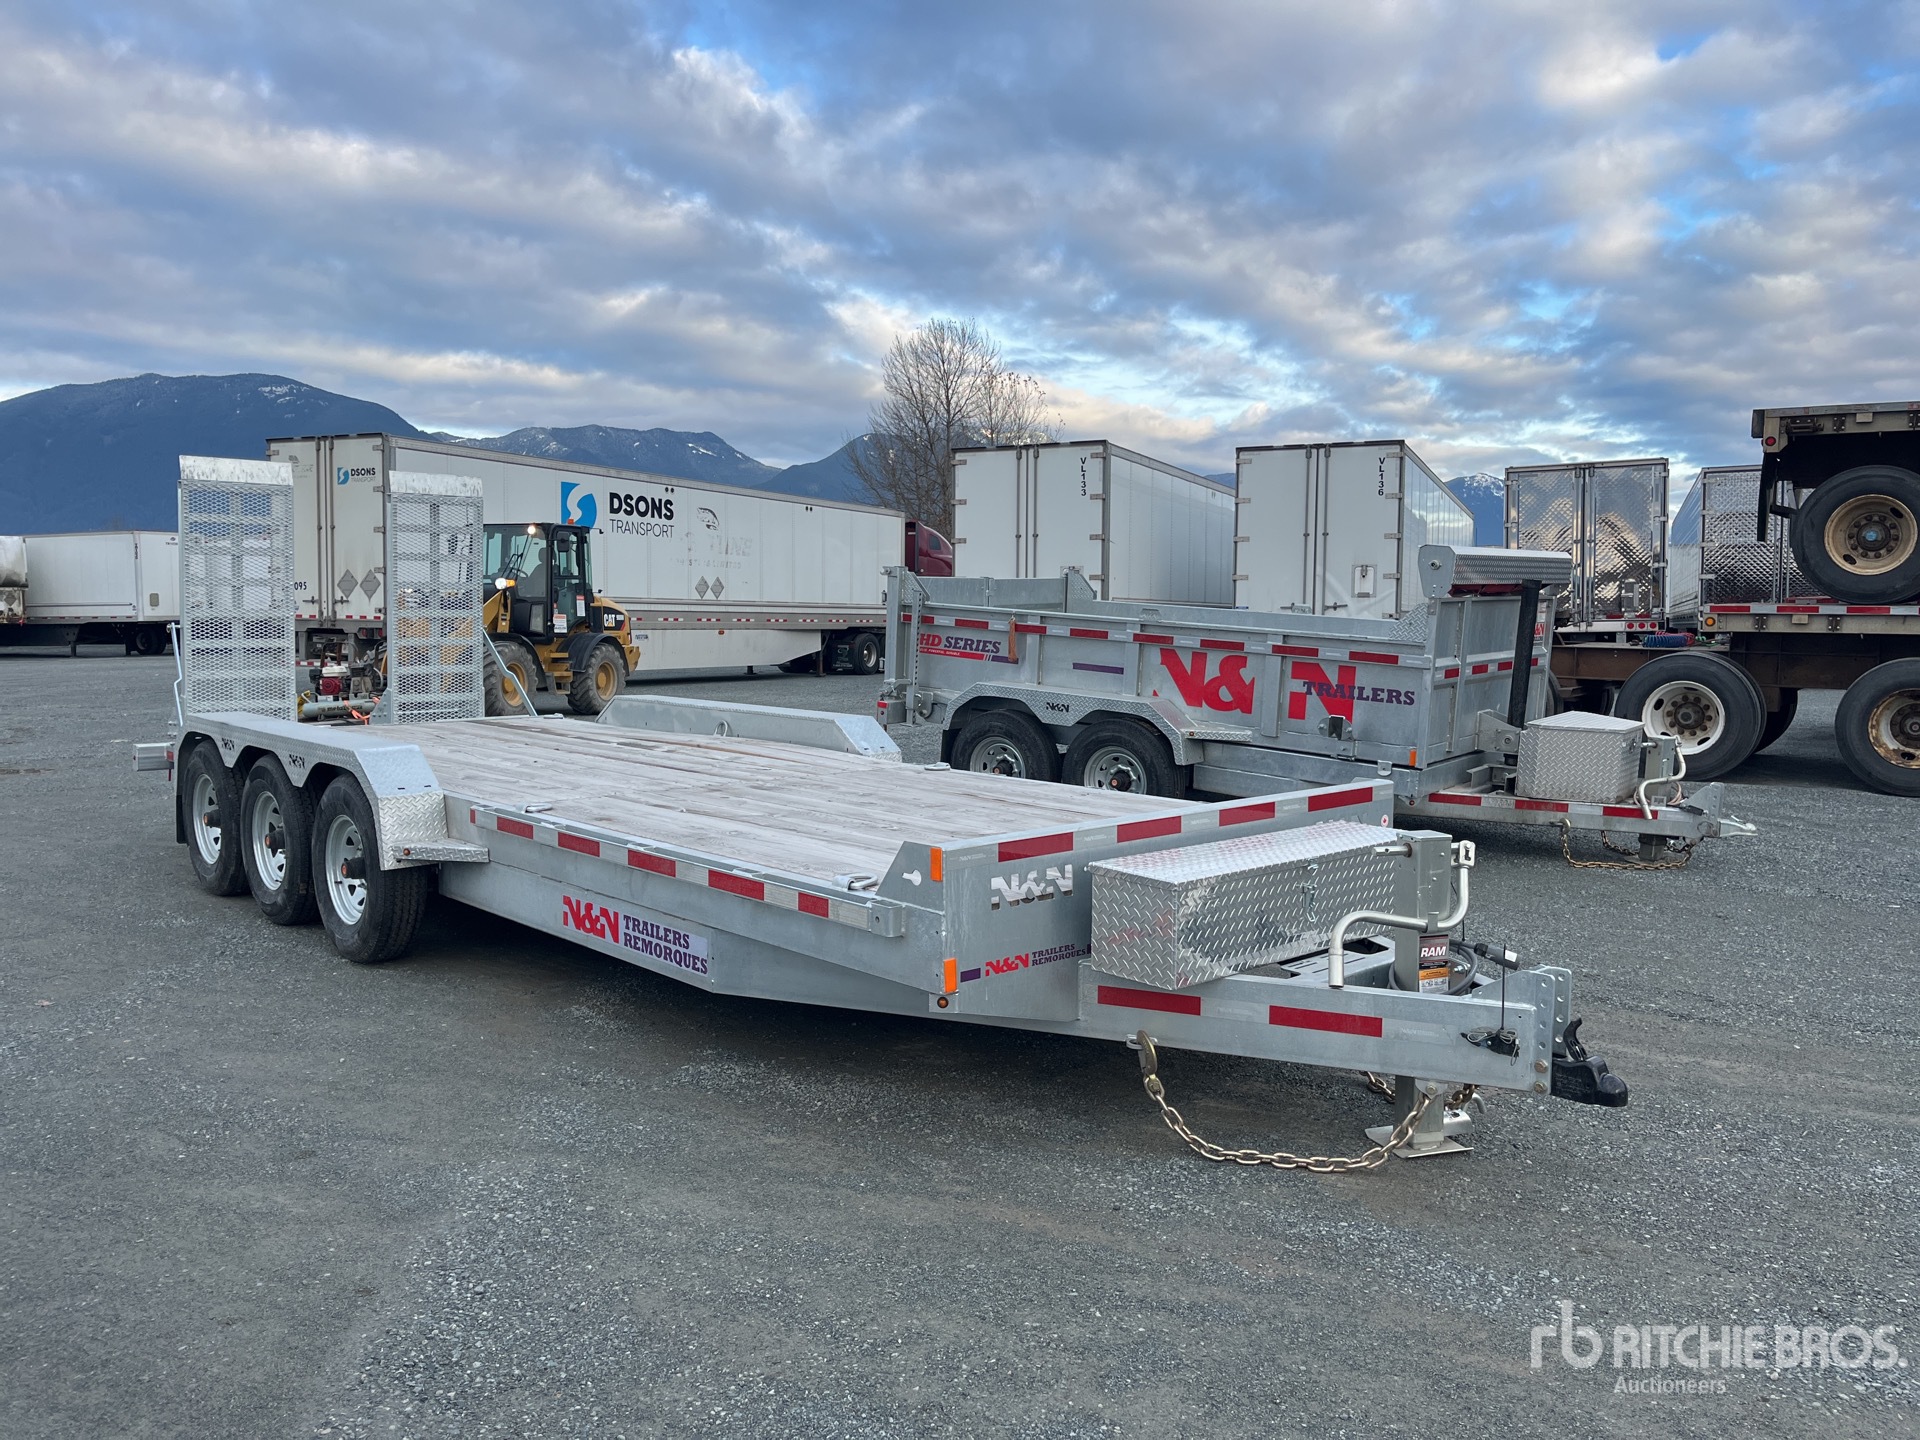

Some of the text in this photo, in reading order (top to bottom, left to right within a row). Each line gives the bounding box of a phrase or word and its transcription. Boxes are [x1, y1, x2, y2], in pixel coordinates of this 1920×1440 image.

[350, 467, 376, 477] DSONS
[1378, 457, 1386, 497] VL136
[609, 492, 675, 521] DSONS
[609, 518, 675, 538] TRANSPORT
[603, 613, 615, 627] CAT
[919, 633, 1002, 654] HD SERIES
[1303, 681, 1415, 706] TRAILERS
[990, 863, 1073, 911] N&N
[562, 895, 620, 944] N&N
[623, 914, 690, 950] TRAILERS
[623, 932, 708, 975] REMORQUES
[1031, 944, 1076, 959] TRAILERS
[1031, 948, 1087, 967] REMORQUES
[1420, 946, 1447, 958] RAM
[985, 953, 1030, 977] N&N
